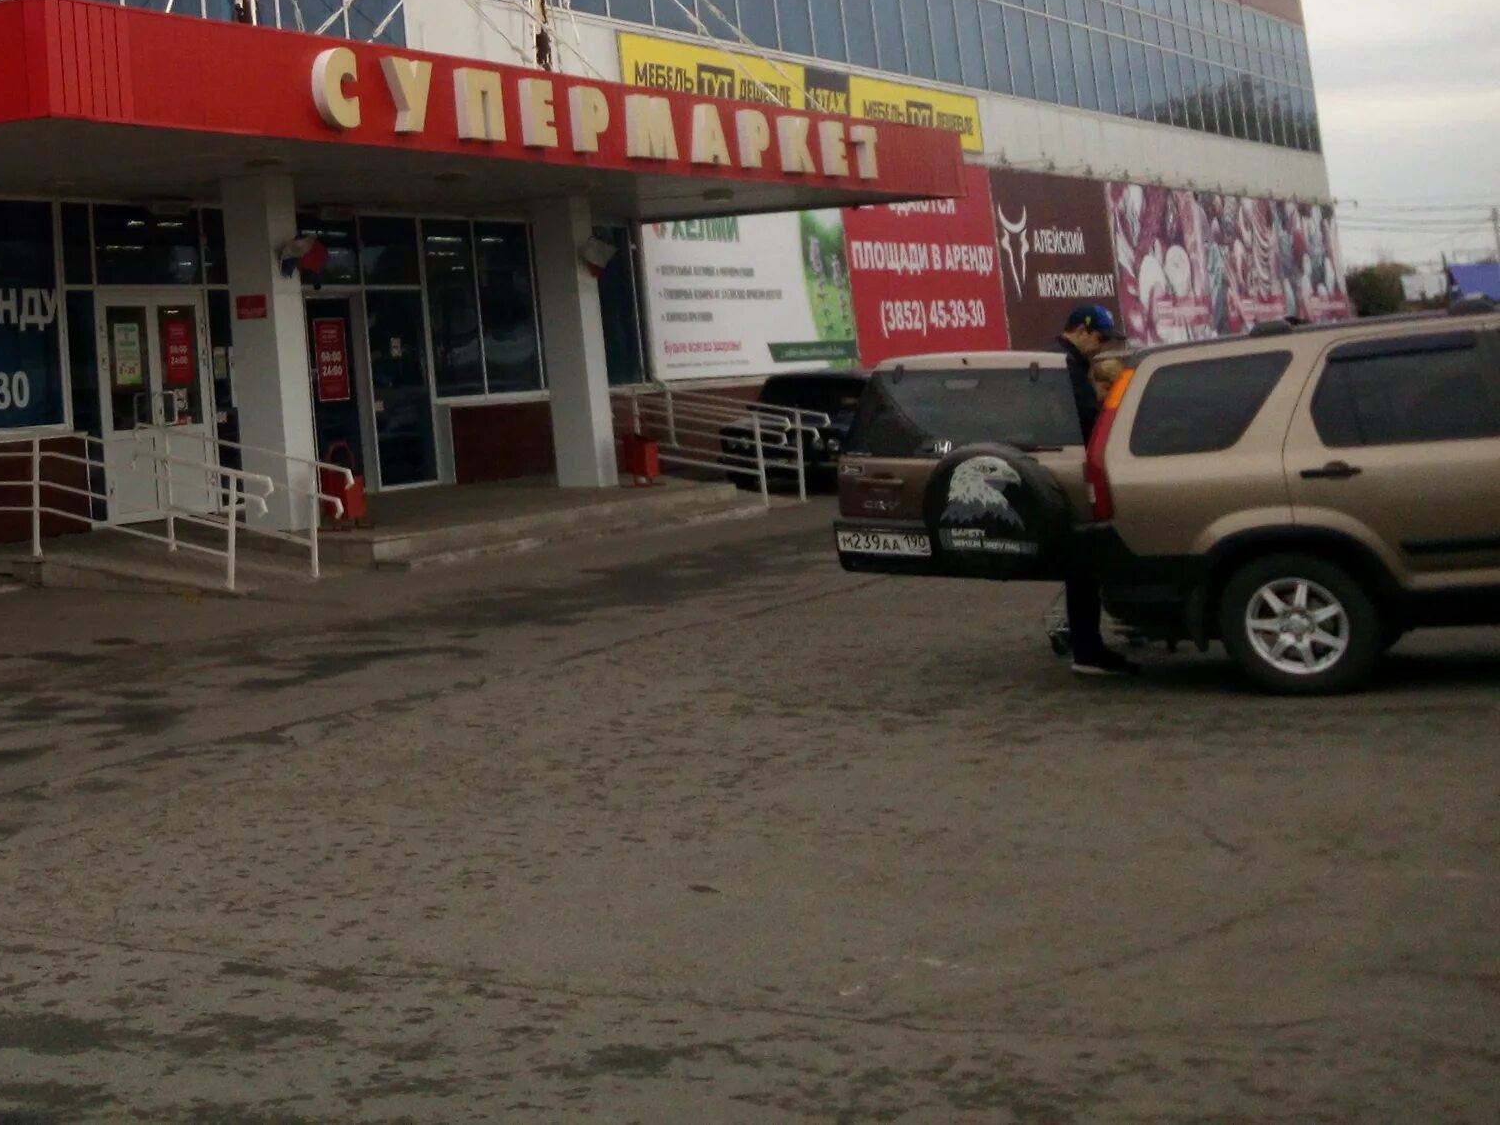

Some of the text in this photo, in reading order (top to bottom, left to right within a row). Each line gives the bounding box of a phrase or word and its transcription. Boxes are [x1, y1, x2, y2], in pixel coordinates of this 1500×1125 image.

[634, 61, 694, 93] МЕБЕЛЬ
[699, 69, 733, 98] ТУТ
[311, 47, 881, 179] СУПЕРМАРКЕТ
[862, 99, 905, 124] МЕБЕЛЬ
[908, 106, 931, 128] ТУТ
[1033, 225, 1085, 255] АЛЕЙСКИЙ
[851, 241, 993, 275] ПЛОЩАДИ В АРЕНДУ
[1037, 273, 1115, 298] МЯСОКОМБИНАТ
[880, 299, 985, 338] (3852) 45-39-30
[903, 533, 927, 548] 190
